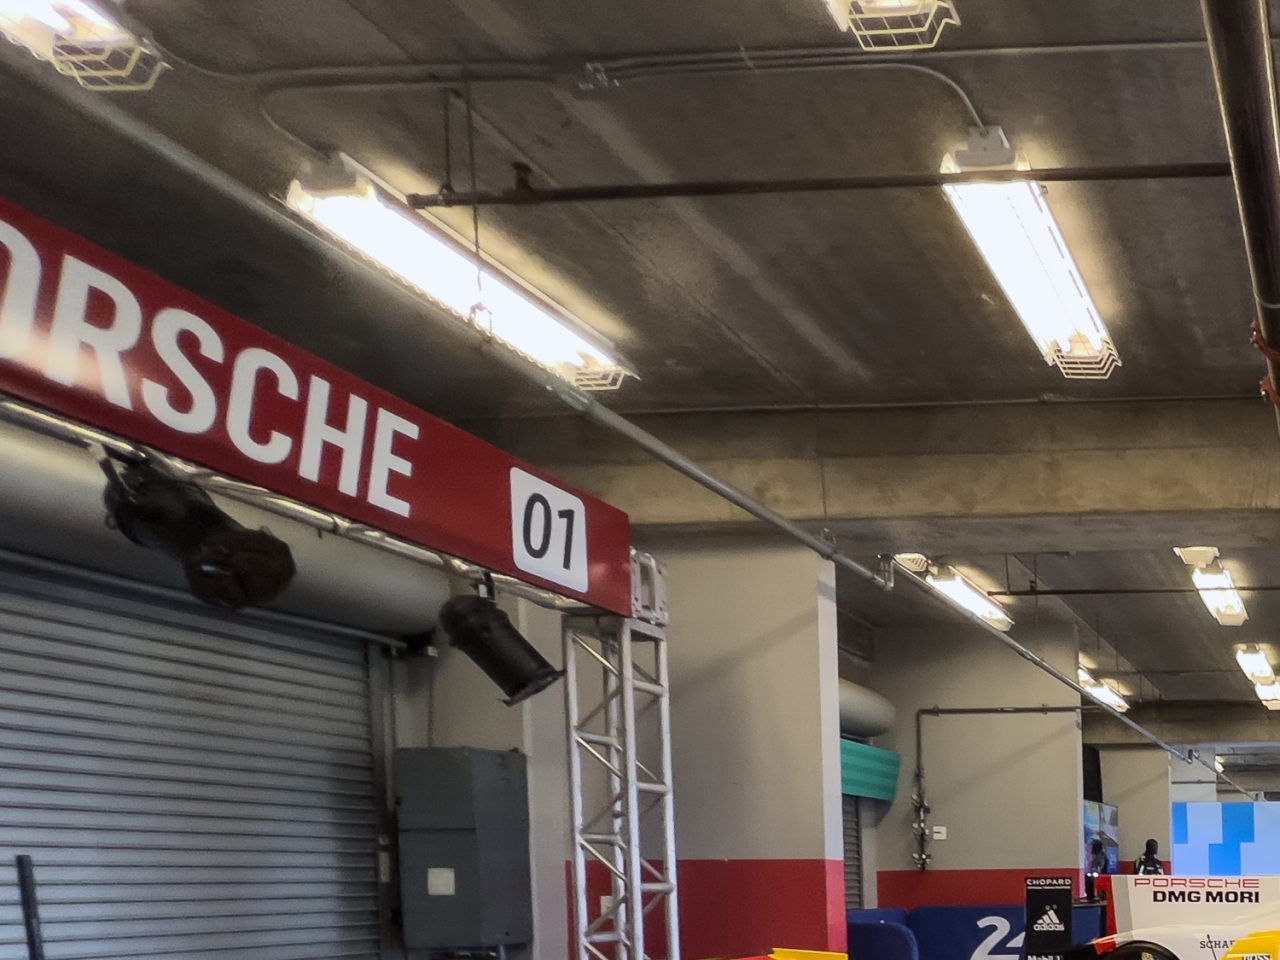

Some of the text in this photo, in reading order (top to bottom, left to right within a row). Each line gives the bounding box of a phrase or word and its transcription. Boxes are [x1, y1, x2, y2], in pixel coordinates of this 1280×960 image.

[522, 492, 577, 570] 01
[1134, 878, 1260, 888] PORSCHE
[1153, 891, 1259, 903] DMG MORI
[1033, 922, 1065, 931] adidas
